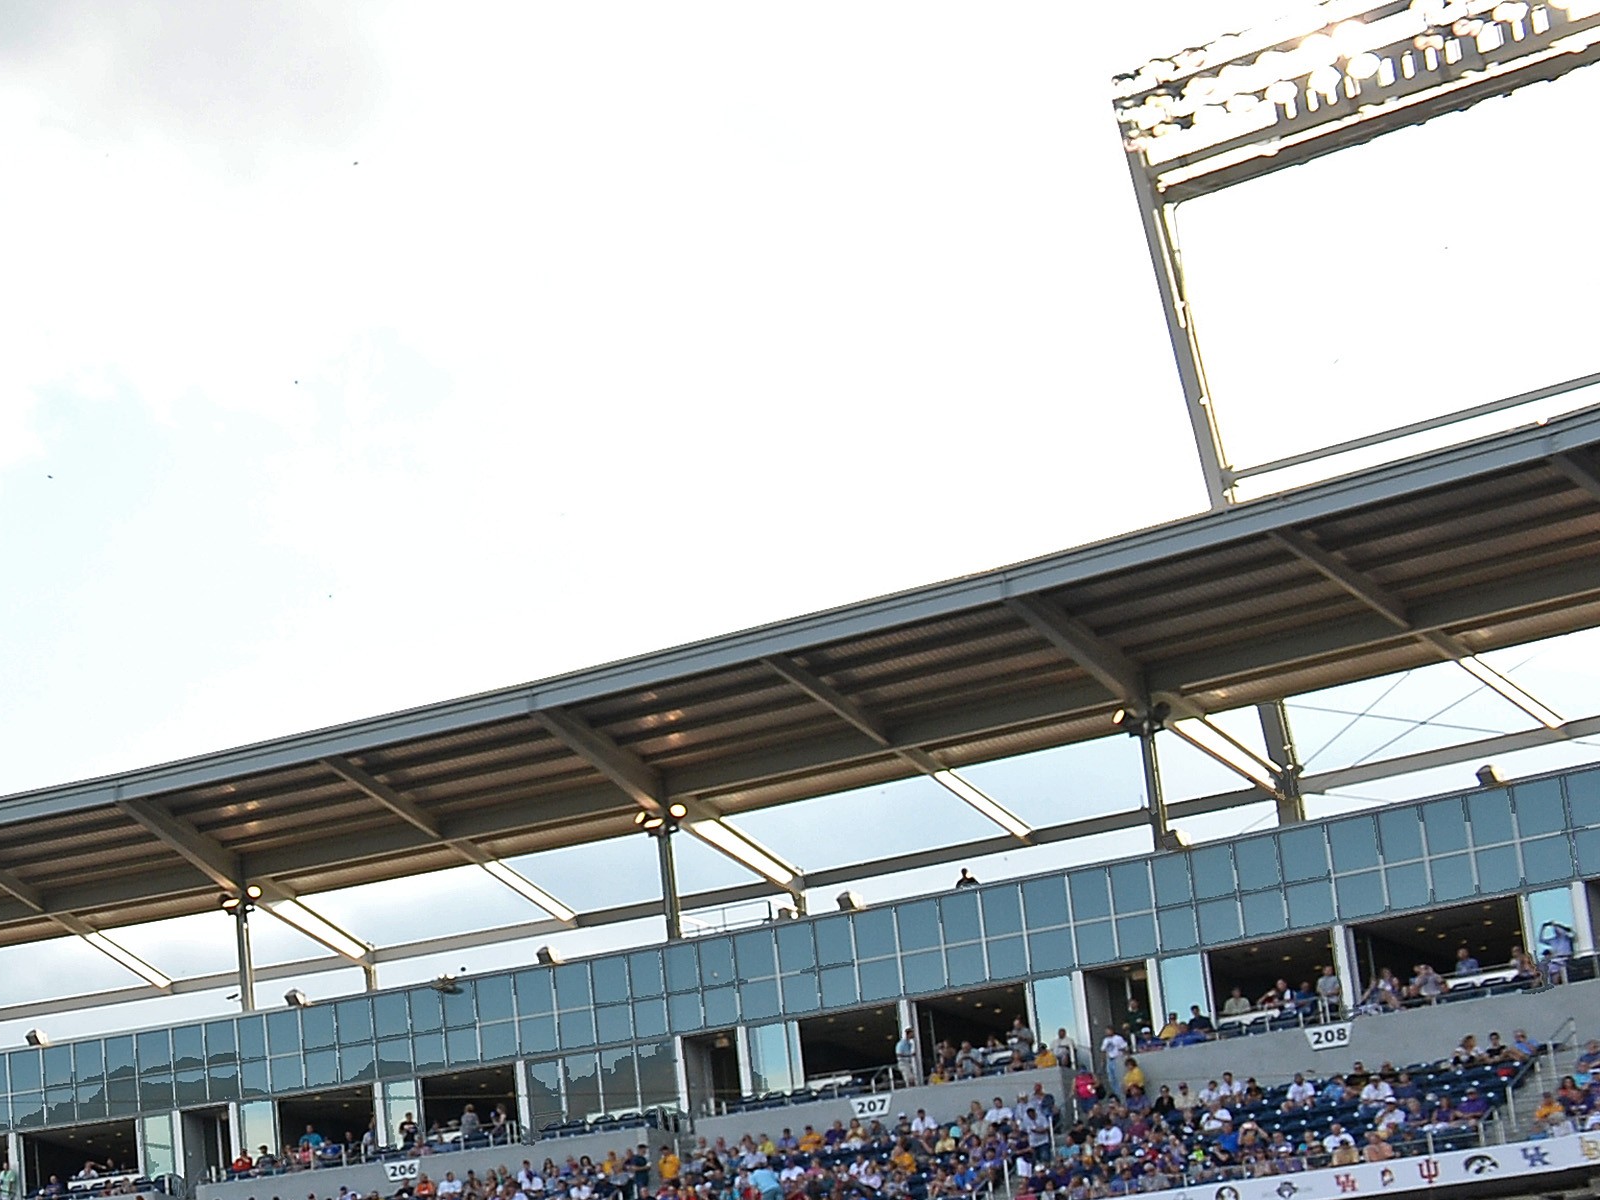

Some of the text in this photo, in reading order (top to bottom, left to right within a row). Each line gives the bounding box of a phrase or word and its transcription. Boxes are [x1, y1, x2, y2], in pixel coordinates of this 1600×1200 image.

[1313, 1028, 1348, 1045] 208
[857, 1099, 886, 1114] 207
[390, 1163, 416, 1177] 206
